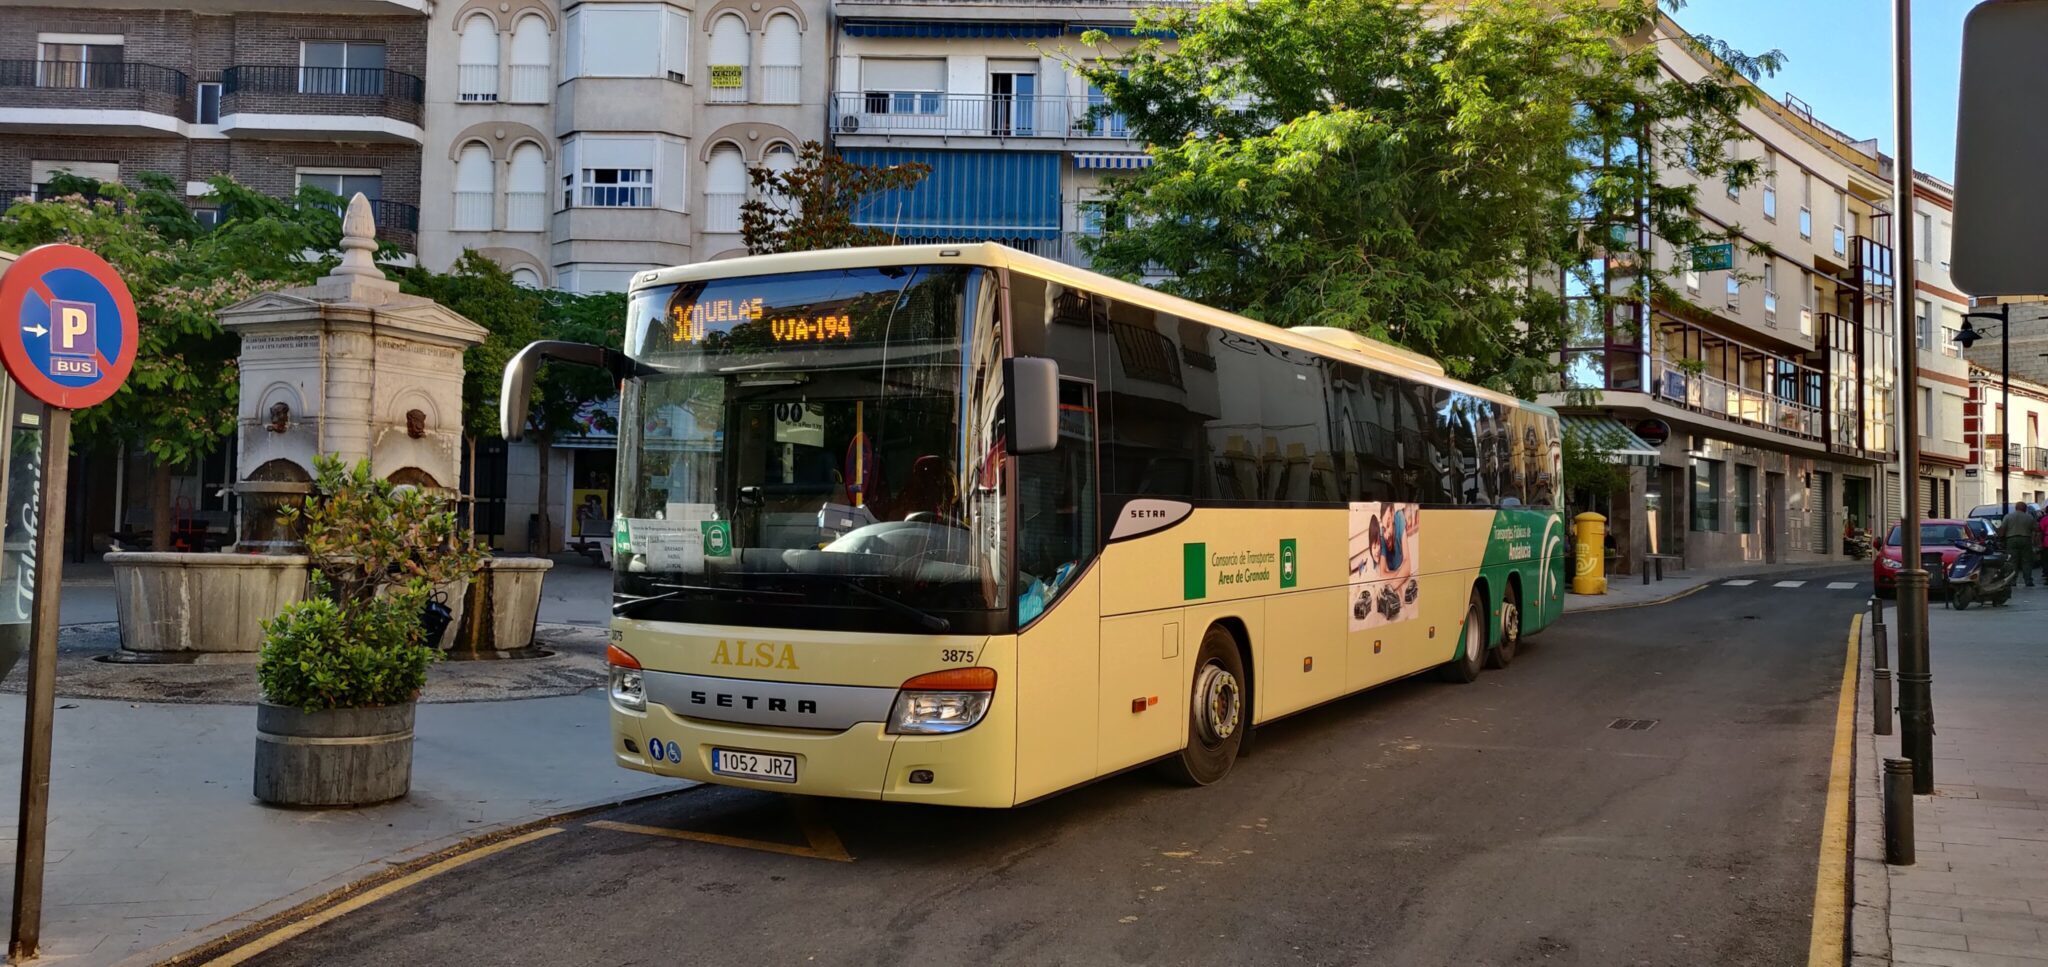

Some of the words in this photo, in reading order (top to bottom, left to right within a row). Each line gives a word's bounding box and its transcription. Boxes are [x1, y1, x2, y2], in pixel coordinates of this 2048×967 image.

[62, 307, 88, 349] P
[673, 305, 704, 341] 360
[57, 361, 92, 373] BUS
[1131, 510, 1166, 518] SETRA
[1212, 552, 1238, 567] Consorcio
[1240, 551, 1246, 565] de
[1246, 550, 1275, 567] Transportes
[1219, 571, 1234, 585] Area
[1235, 569, 1243, 583] de
[1244, 568, 1270, 583] Granada
[711, 640, 800, 670] ALSA
[941, 649, 974, 663] 3875
[691, 690, 817, 714] SETRA
[723, 753, 758, 772] 1052
[764, 757, 793, 776] JRZ
